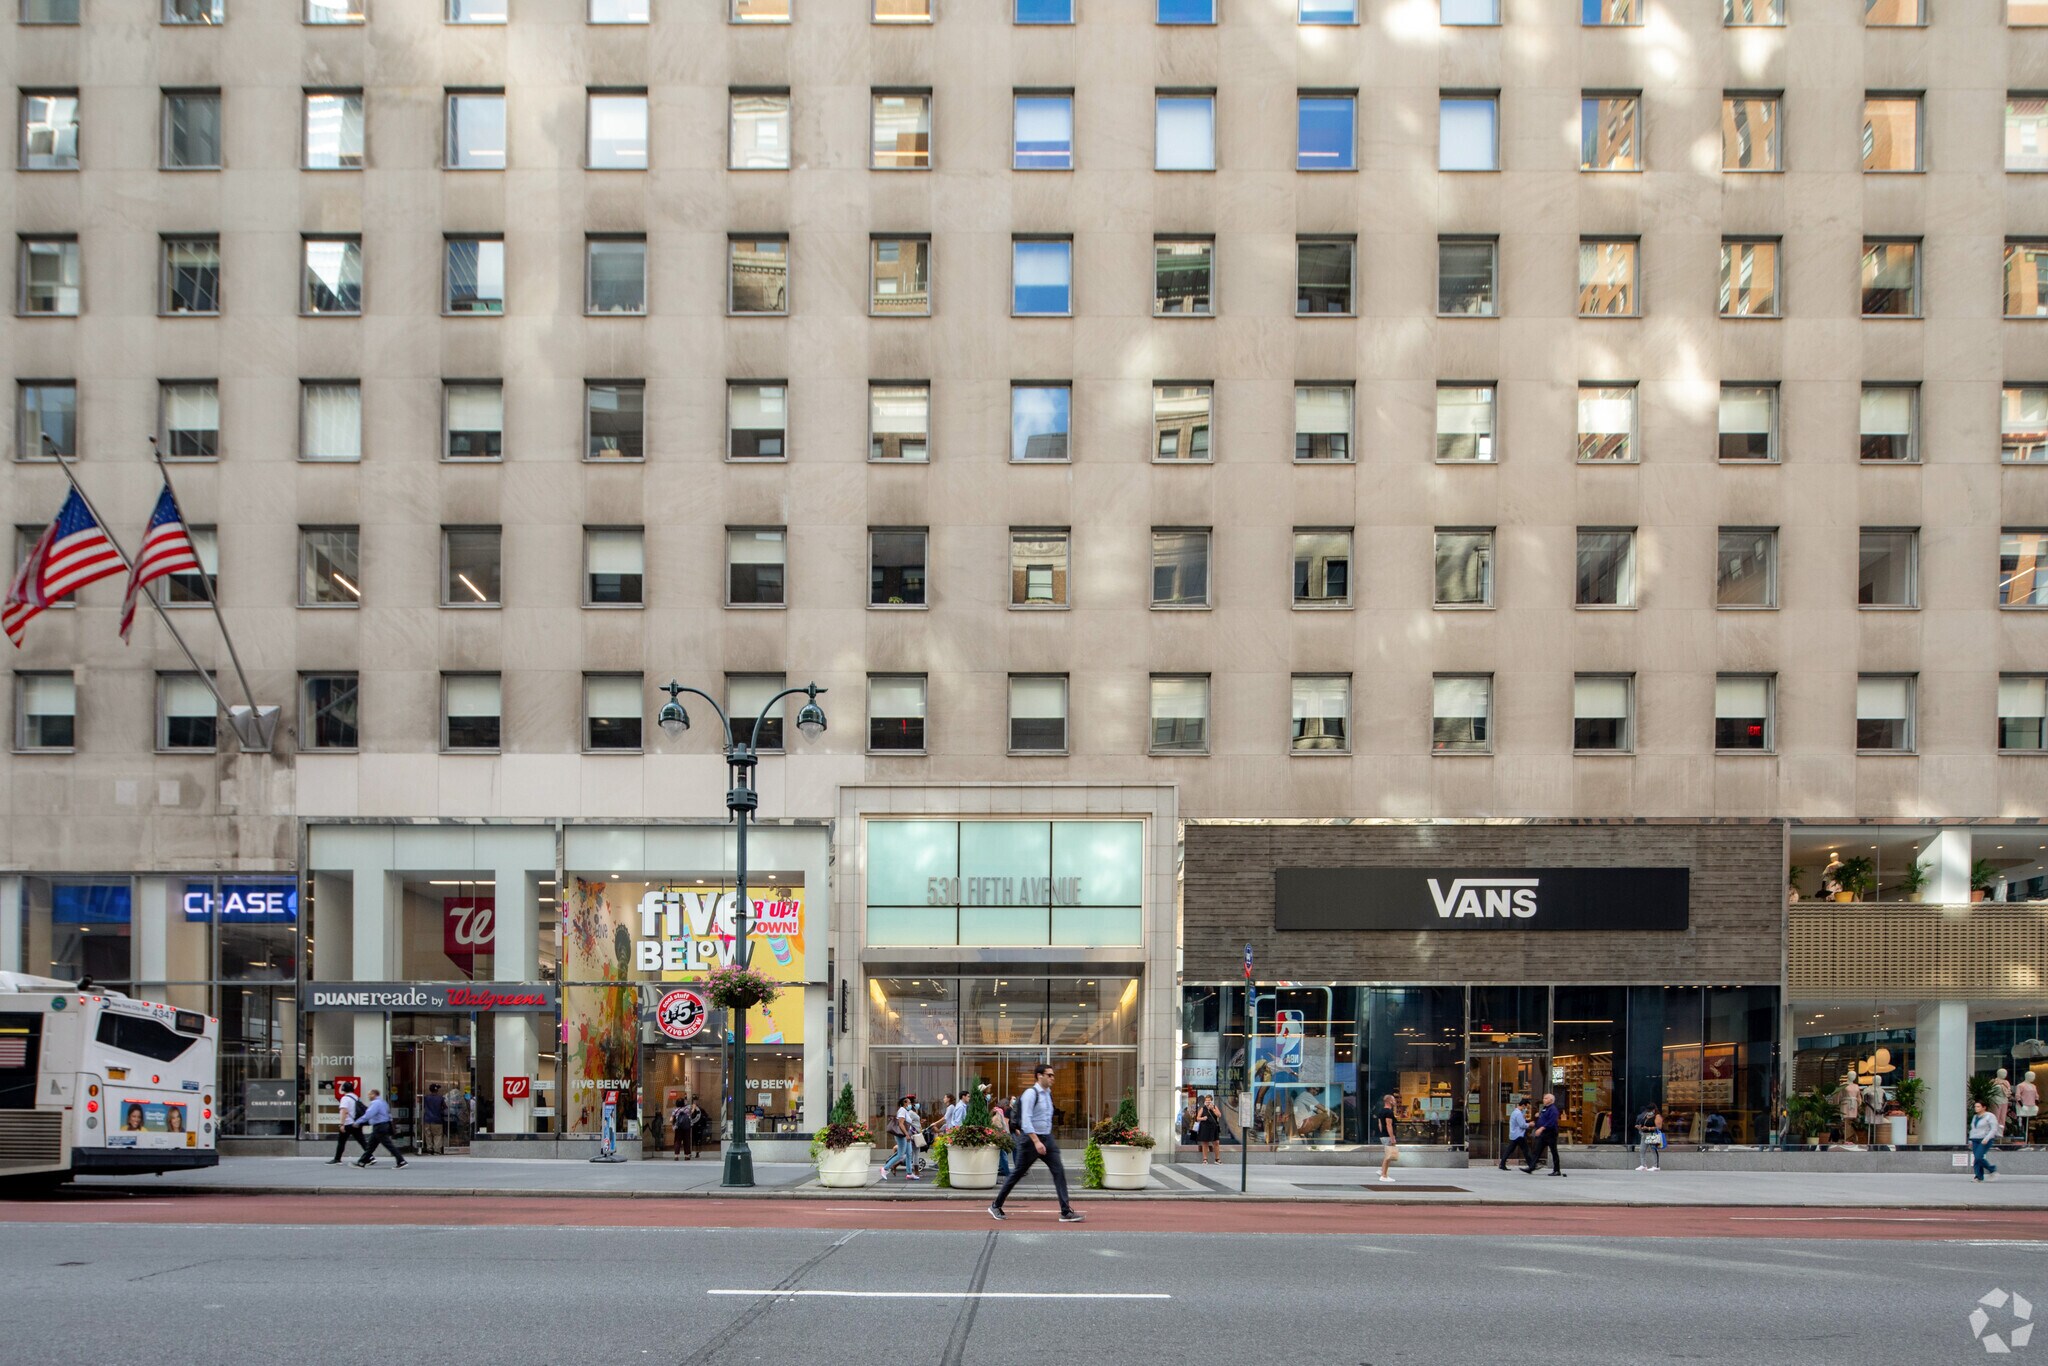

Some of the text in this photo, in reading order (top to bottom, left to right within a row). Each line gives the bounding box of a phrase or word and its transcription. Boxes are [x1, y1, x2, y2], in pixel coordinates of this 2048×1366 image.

[927, 877, 1082, 905] 530 FIFTH AVENUE
[1426, 878, 1539, 918] VANS
[184, 893, 285, 913] CHASE
[769, 901, 799, 919] UP!
[637, 891, 755, 936] five
[755, 921, 797, 933] OWN!
[431, 996, 444, 1007] by
[446, 988, 548, 1010] Walgreens
[663, 996, 674, 1008] cool
[152, 1009, 175, 1020] 4347
[571, 1080, 595, 1089] five
[745, 1080, 760, 1089] ve
